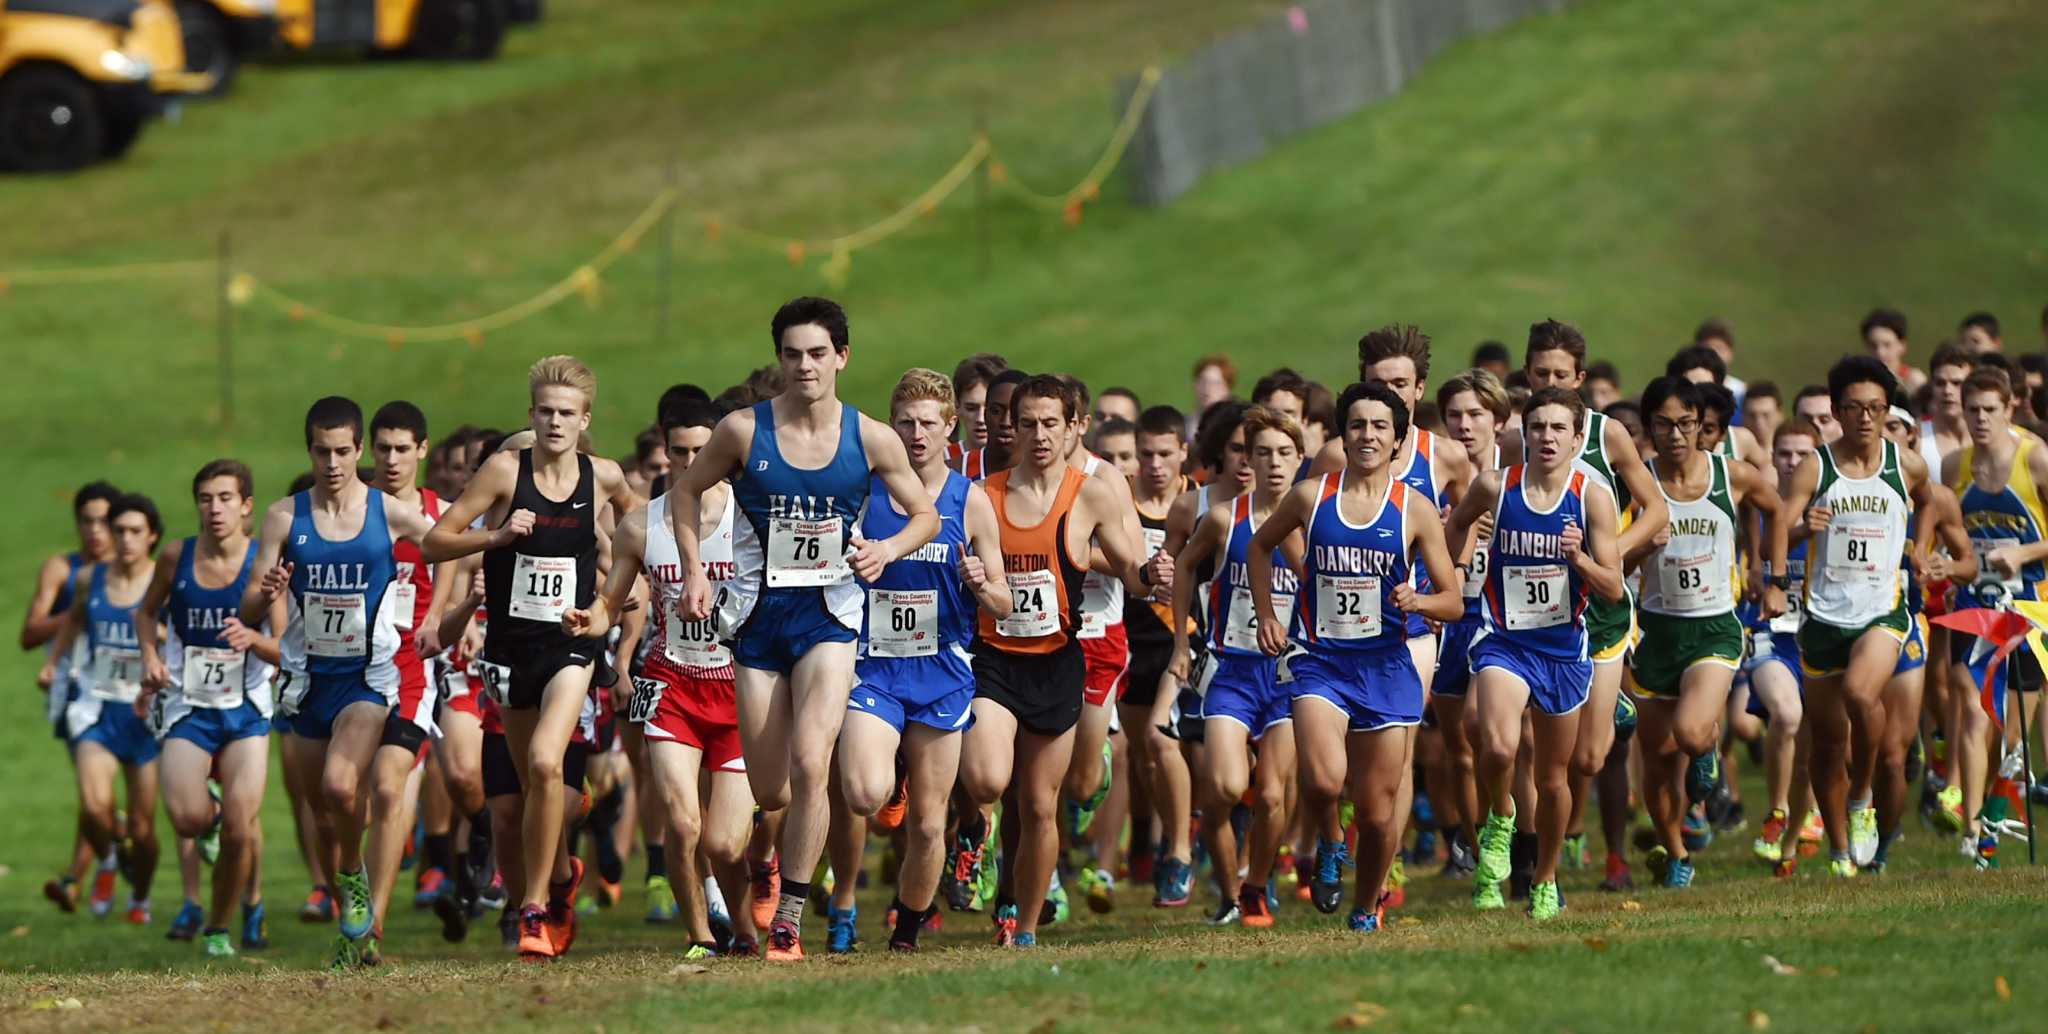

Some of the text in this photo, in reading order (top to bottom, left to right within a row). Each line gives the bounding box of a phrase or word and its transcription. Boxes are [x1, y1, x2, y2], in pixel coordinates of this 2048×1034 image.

[769, 495, 841, 518] HALL
[1831, 496, 1888, 515] HAMDEN
[1670, 519, 1718, 537] AMDEN
[793, 537, 820, 560] 76
[1848, 540, 1868, 562] 81
[1003, 553, 1049, 573] HELTON
[1315, 545, 1396, 576] DANBURY
[1475, 552, 1486, 574] 3
[307, 564, 369, 590] HALL
[648, 561, 737, 584] WILATS
[1230, 562, 1298, 593] DAURY
[1679, 569, 1701, 589] 83
[527, 573, 563, 597] 118
[1525, 581, 1549, 604] 30
[892, 599, 933, 607] Championships
[1010, 588, 1043, 613] 124
[1336, 592, 1360, 616] 32
[323, 610, 345, 633] 77
[892, 608, 916, 632] 60
[203, 663, 225, 684] 75
